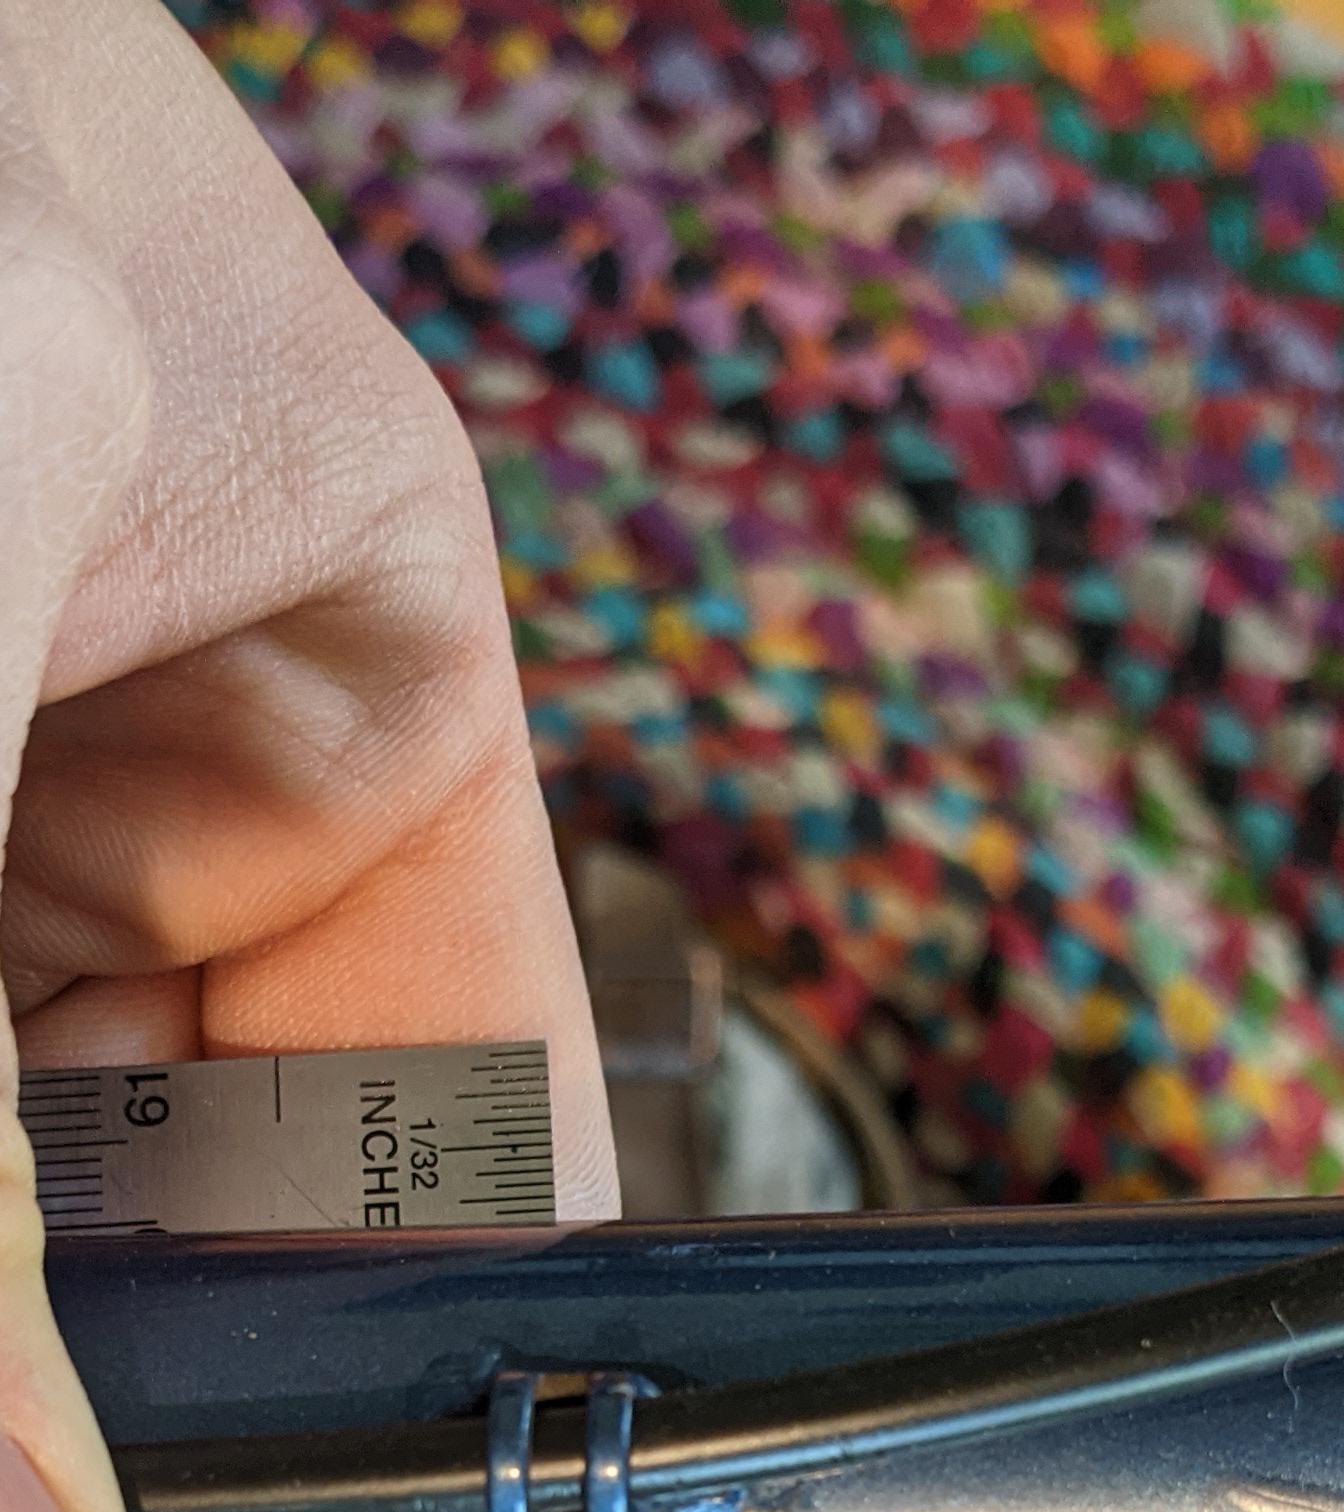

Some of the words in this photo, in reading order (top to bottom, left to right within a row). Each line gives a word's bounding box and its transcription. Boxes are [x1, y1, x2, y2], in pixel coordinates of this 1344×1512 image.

[125, 1073, 169, 1127] 61
[359, 1080, 401, 1227] INCHE
[409, 1118, 439, 1190] 1/32
